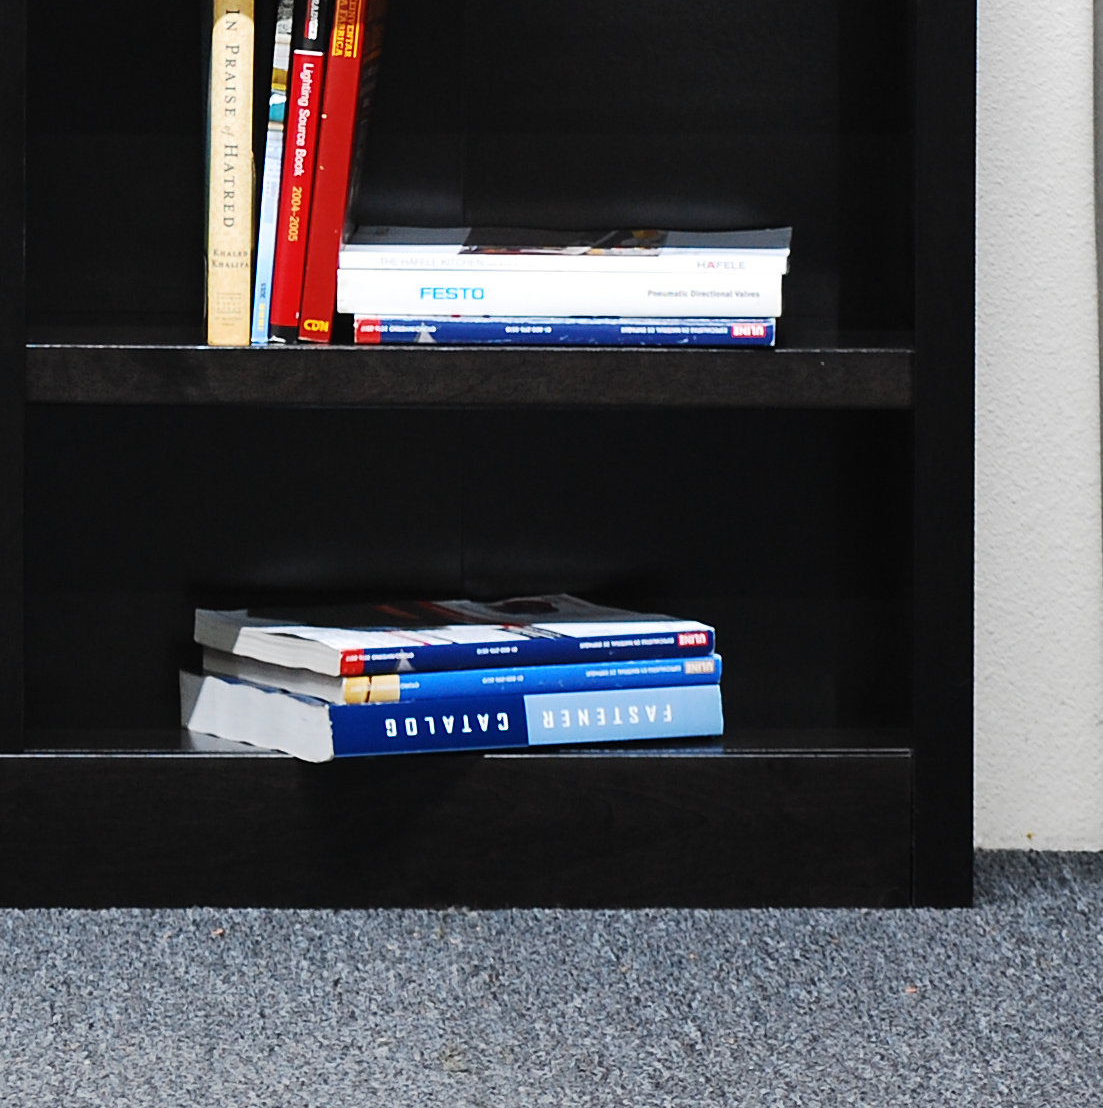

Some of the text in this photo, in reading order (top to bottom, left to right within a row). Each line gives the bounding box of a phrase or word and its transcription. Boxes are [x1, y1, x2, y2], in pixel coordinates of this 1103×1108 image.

[225, 9, 241, 31] IN
[225, 45, 240, 117] PRAISE
[288, 63, 314, 242] Lighting Source Book 2004-2005
[223, 144, 239, 228] HATRED
[419, 287, 485, 300] FESTO
[647, 289, 760, 298] Pneumatic Directional Valves
[303, 319, 330, 332] CDN
[384, 704, 672, 738] FASTENER CATALOG
